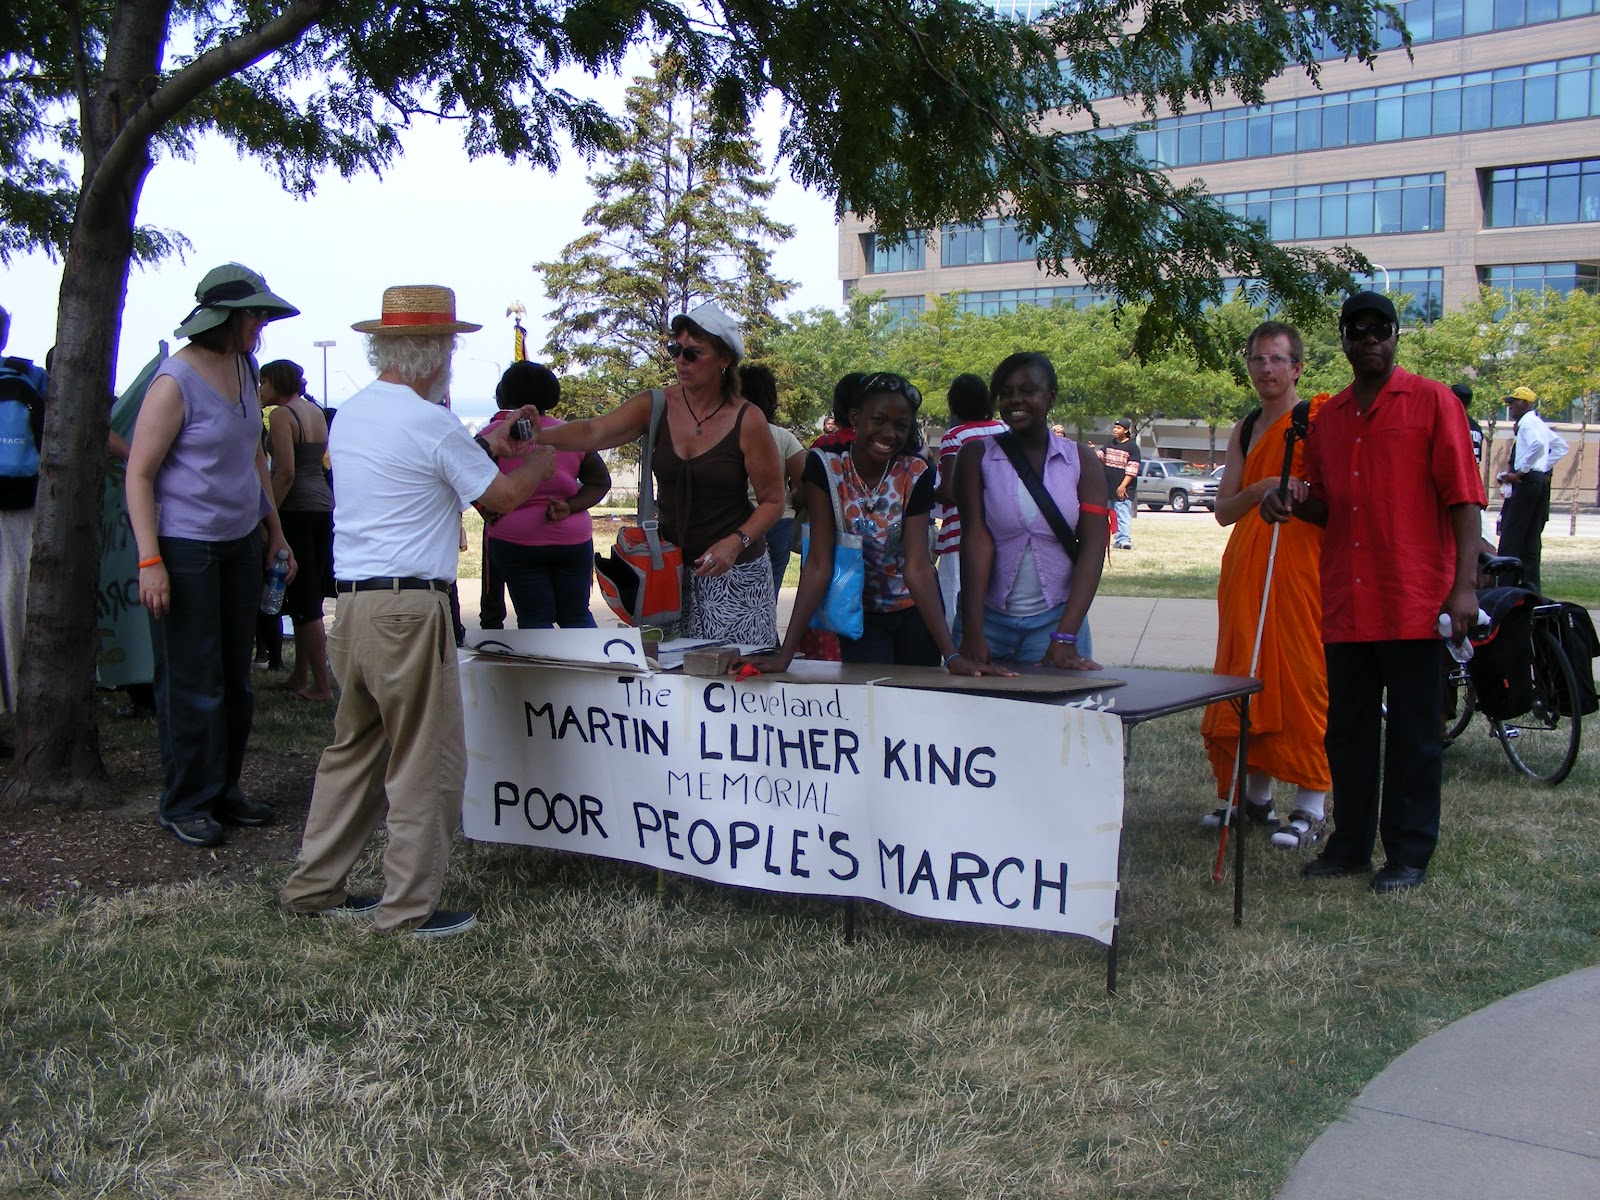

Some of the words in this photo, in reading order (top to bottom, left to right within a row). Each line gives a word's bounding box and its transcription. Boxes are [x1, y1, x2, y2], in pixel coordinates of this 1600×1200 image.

[617, 676, 672, 708] The
[703, 682, 850, 721] Cleveland
[524, 701, 669, 756] MARTIN
[700, 721, 861, 775] LUTHER
[884, 736, 996, 788] KING
[668, 770, 840, 816] MEMORIAL
[494, 781, 609, 839] POOR
[633, 801, 860, 881] PEOPLE'S
[878, 838, 1068, 915] MARCH
